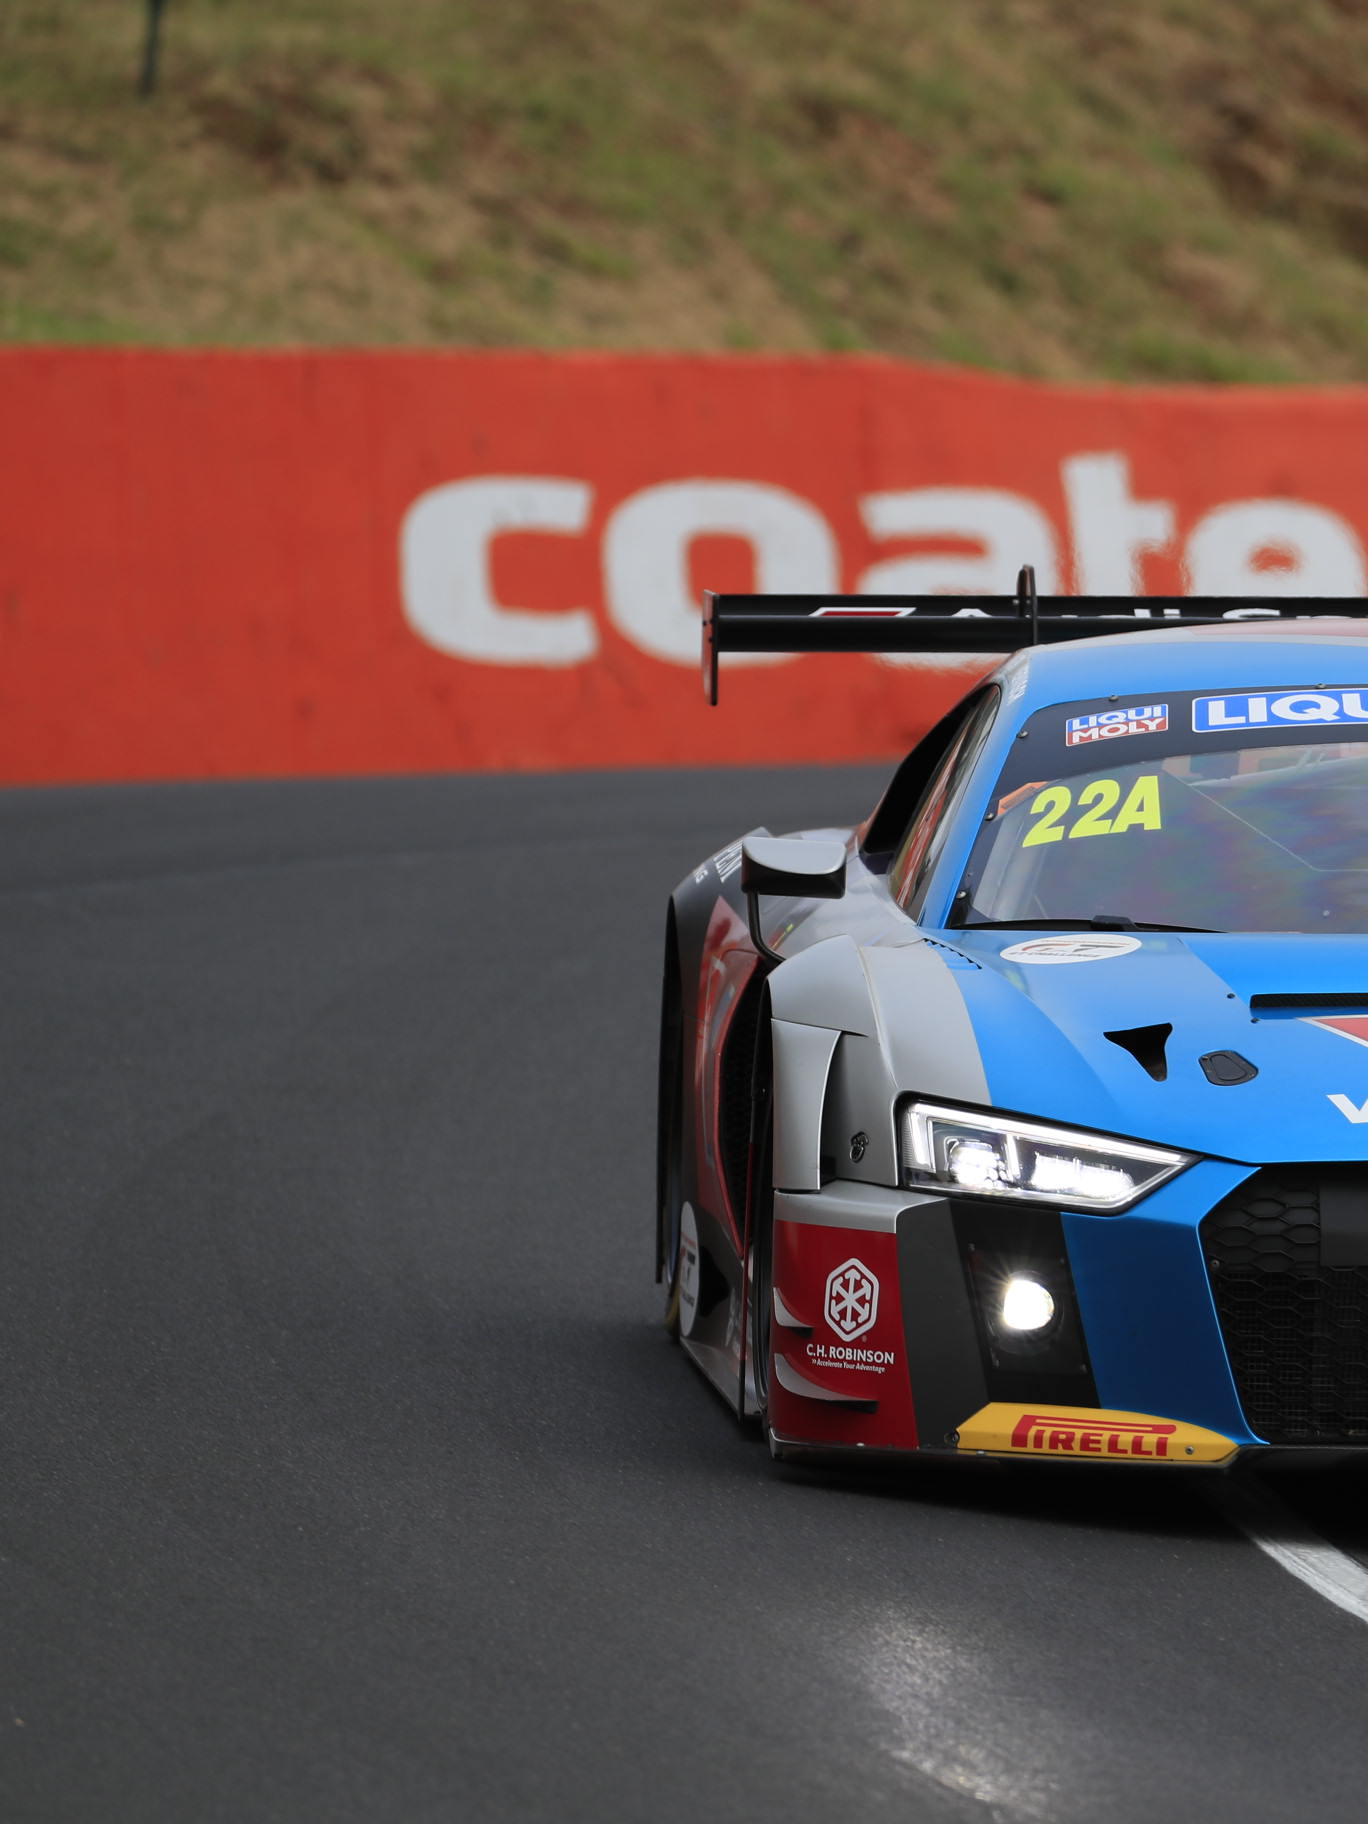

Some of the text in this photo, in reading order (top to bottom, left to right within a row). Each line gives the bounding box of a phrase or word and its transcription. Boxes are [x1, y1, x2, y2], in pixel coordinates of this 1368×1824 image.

[1071, 717, 1166, 744] MOLY
[1072, 705, 1162, 731] LIQUI
[1022, 775, 1162, 848] 22A
[829, 1345, 895, 1365] ROBINSON
[1011, 1414, 1177, 1457] PIRELLI
